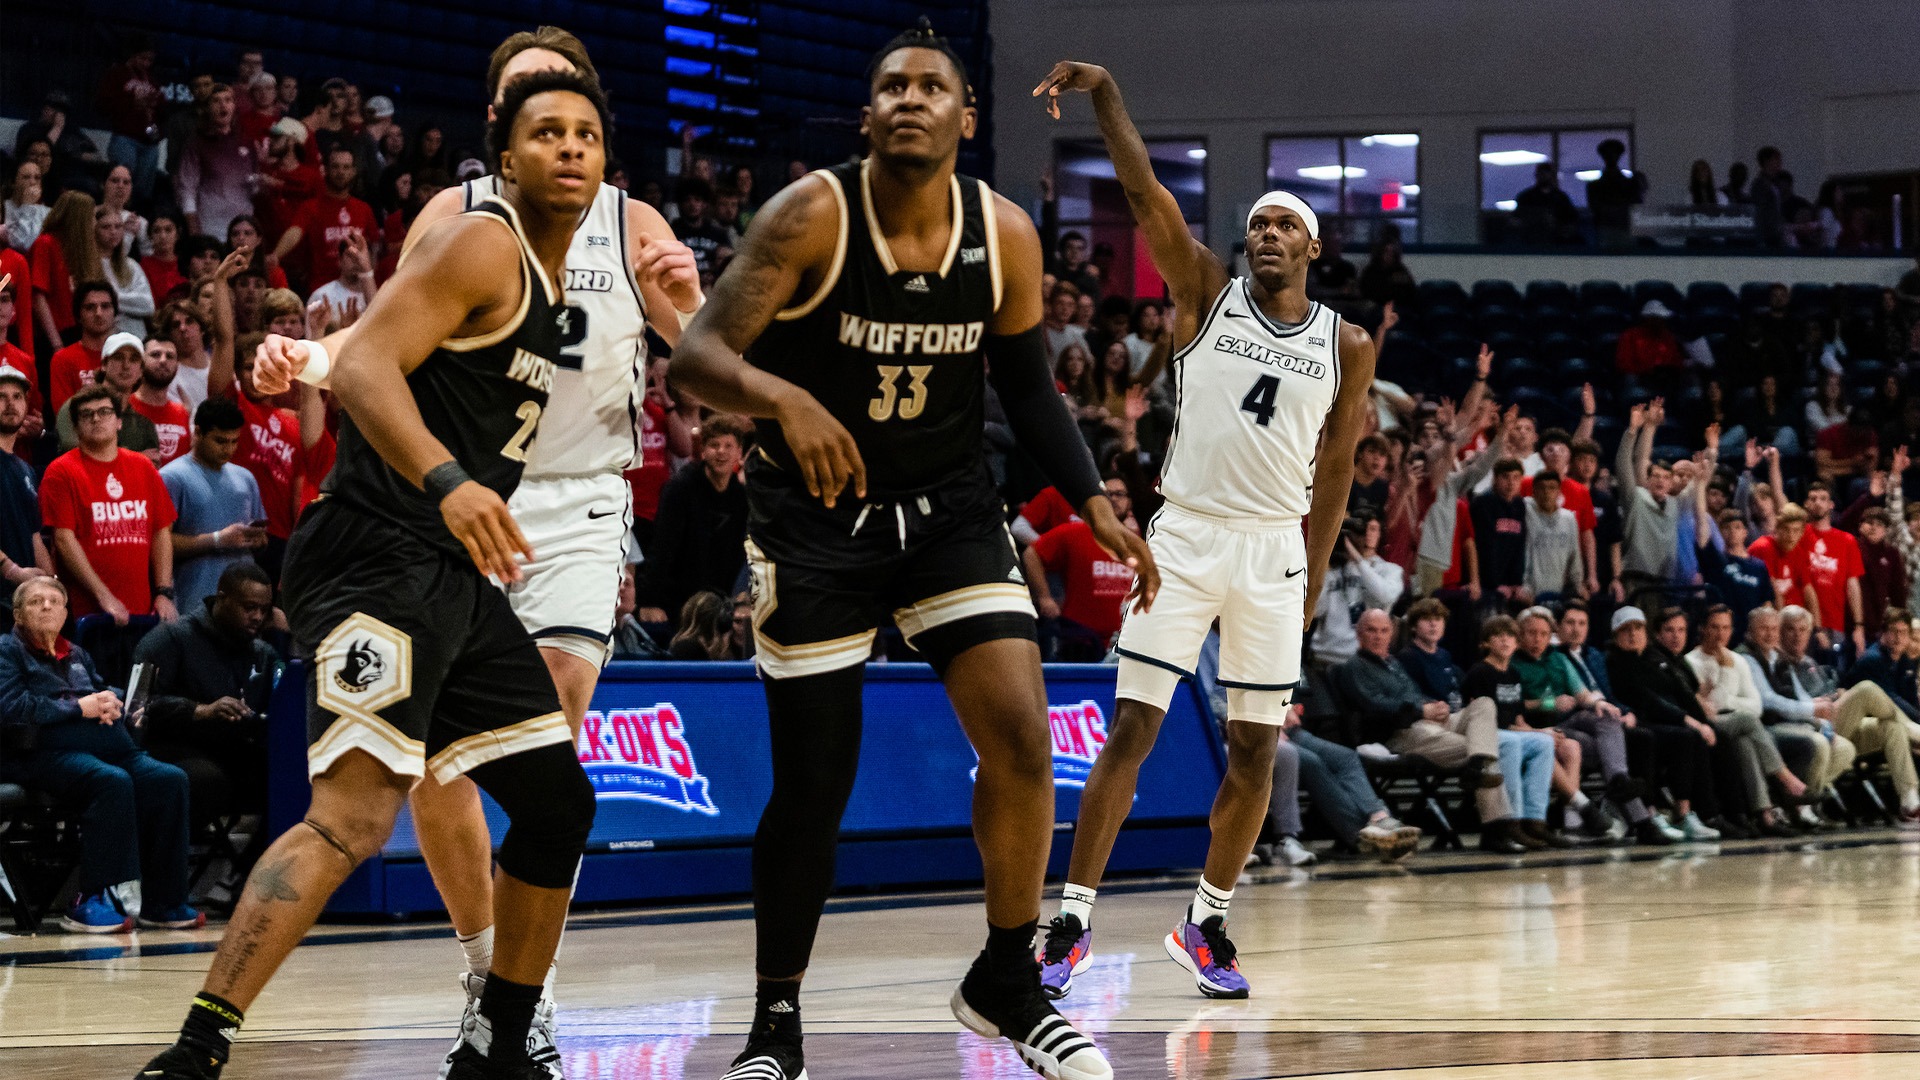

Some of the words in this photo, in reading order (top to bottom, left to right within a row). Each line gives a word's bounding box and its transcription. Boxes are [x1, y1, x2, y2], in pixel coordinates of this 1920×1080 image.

[838, 310, 984, 355] WOFFORD
[1214, 334, 1326, 381] SAMFORD
[868, 364, 934, 422] 33
[1239, 372, 1282, 428] 4
[91, 500, 148, 523] BUCK
[609, 840, 654, 850] DAKTRONICS
[768, 1005, 794, 1013] adidas
